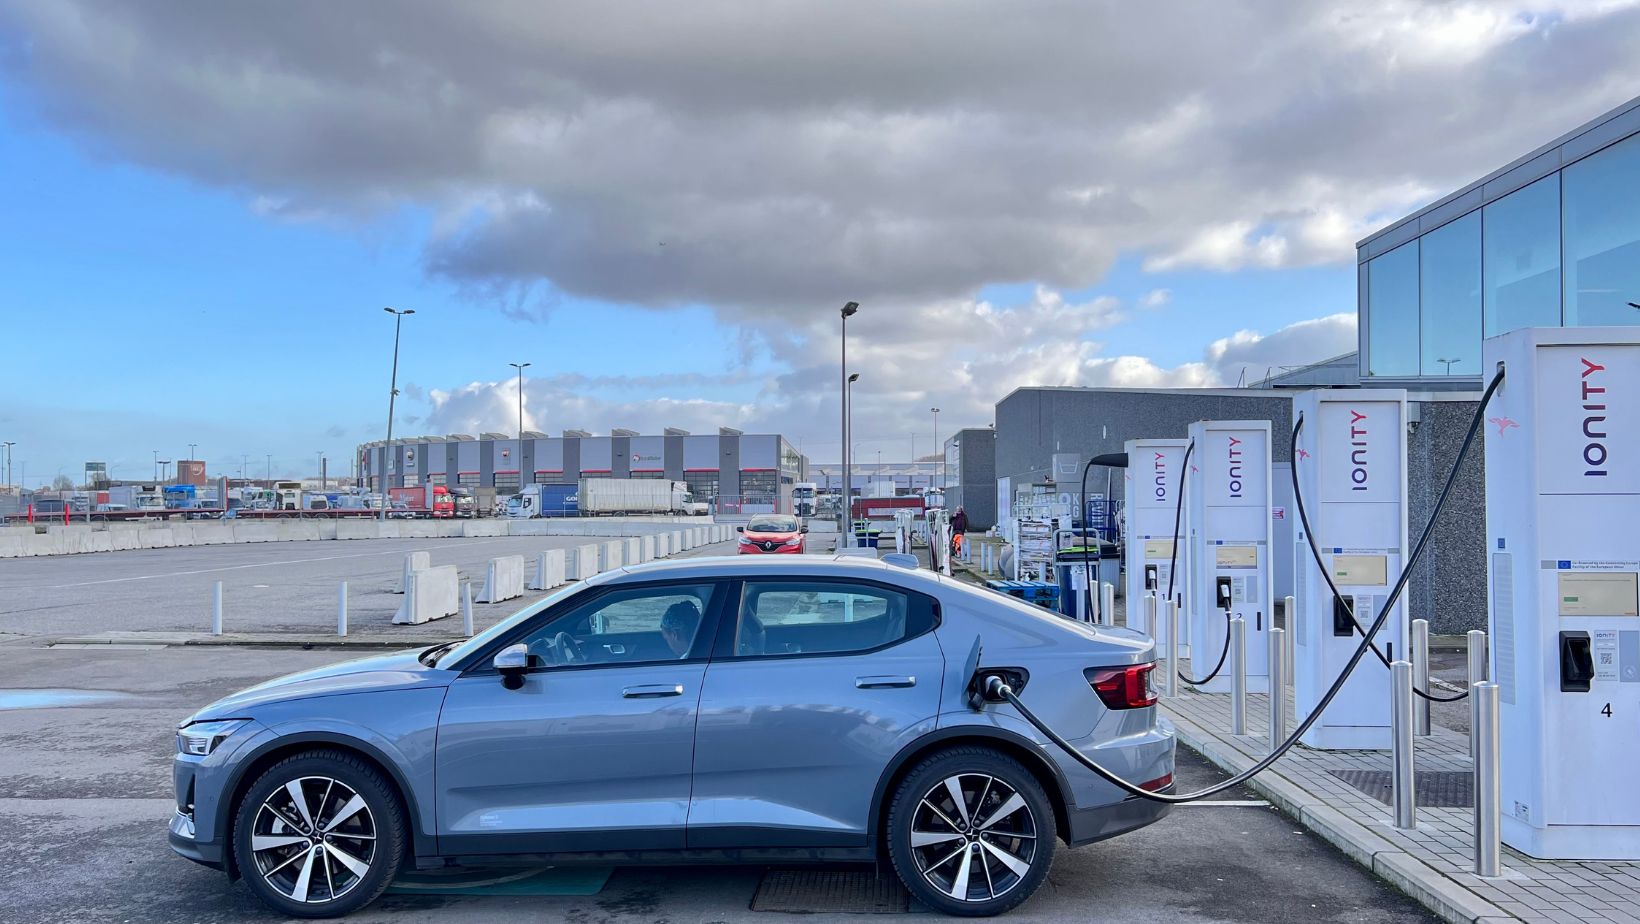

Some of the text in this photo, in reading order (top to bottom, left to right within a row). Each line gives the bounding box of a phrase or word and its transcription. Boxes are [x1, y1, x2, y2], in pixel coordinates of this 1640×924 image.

[1581, 357, 1608, 476] IONITY
[1154, 452, 1166, 501] IONITY
[1228, 436, 1242, 498] IONITY
[1350, 409, 1368, 491] IONITY
[1600, 702, 1613, 718] 4
